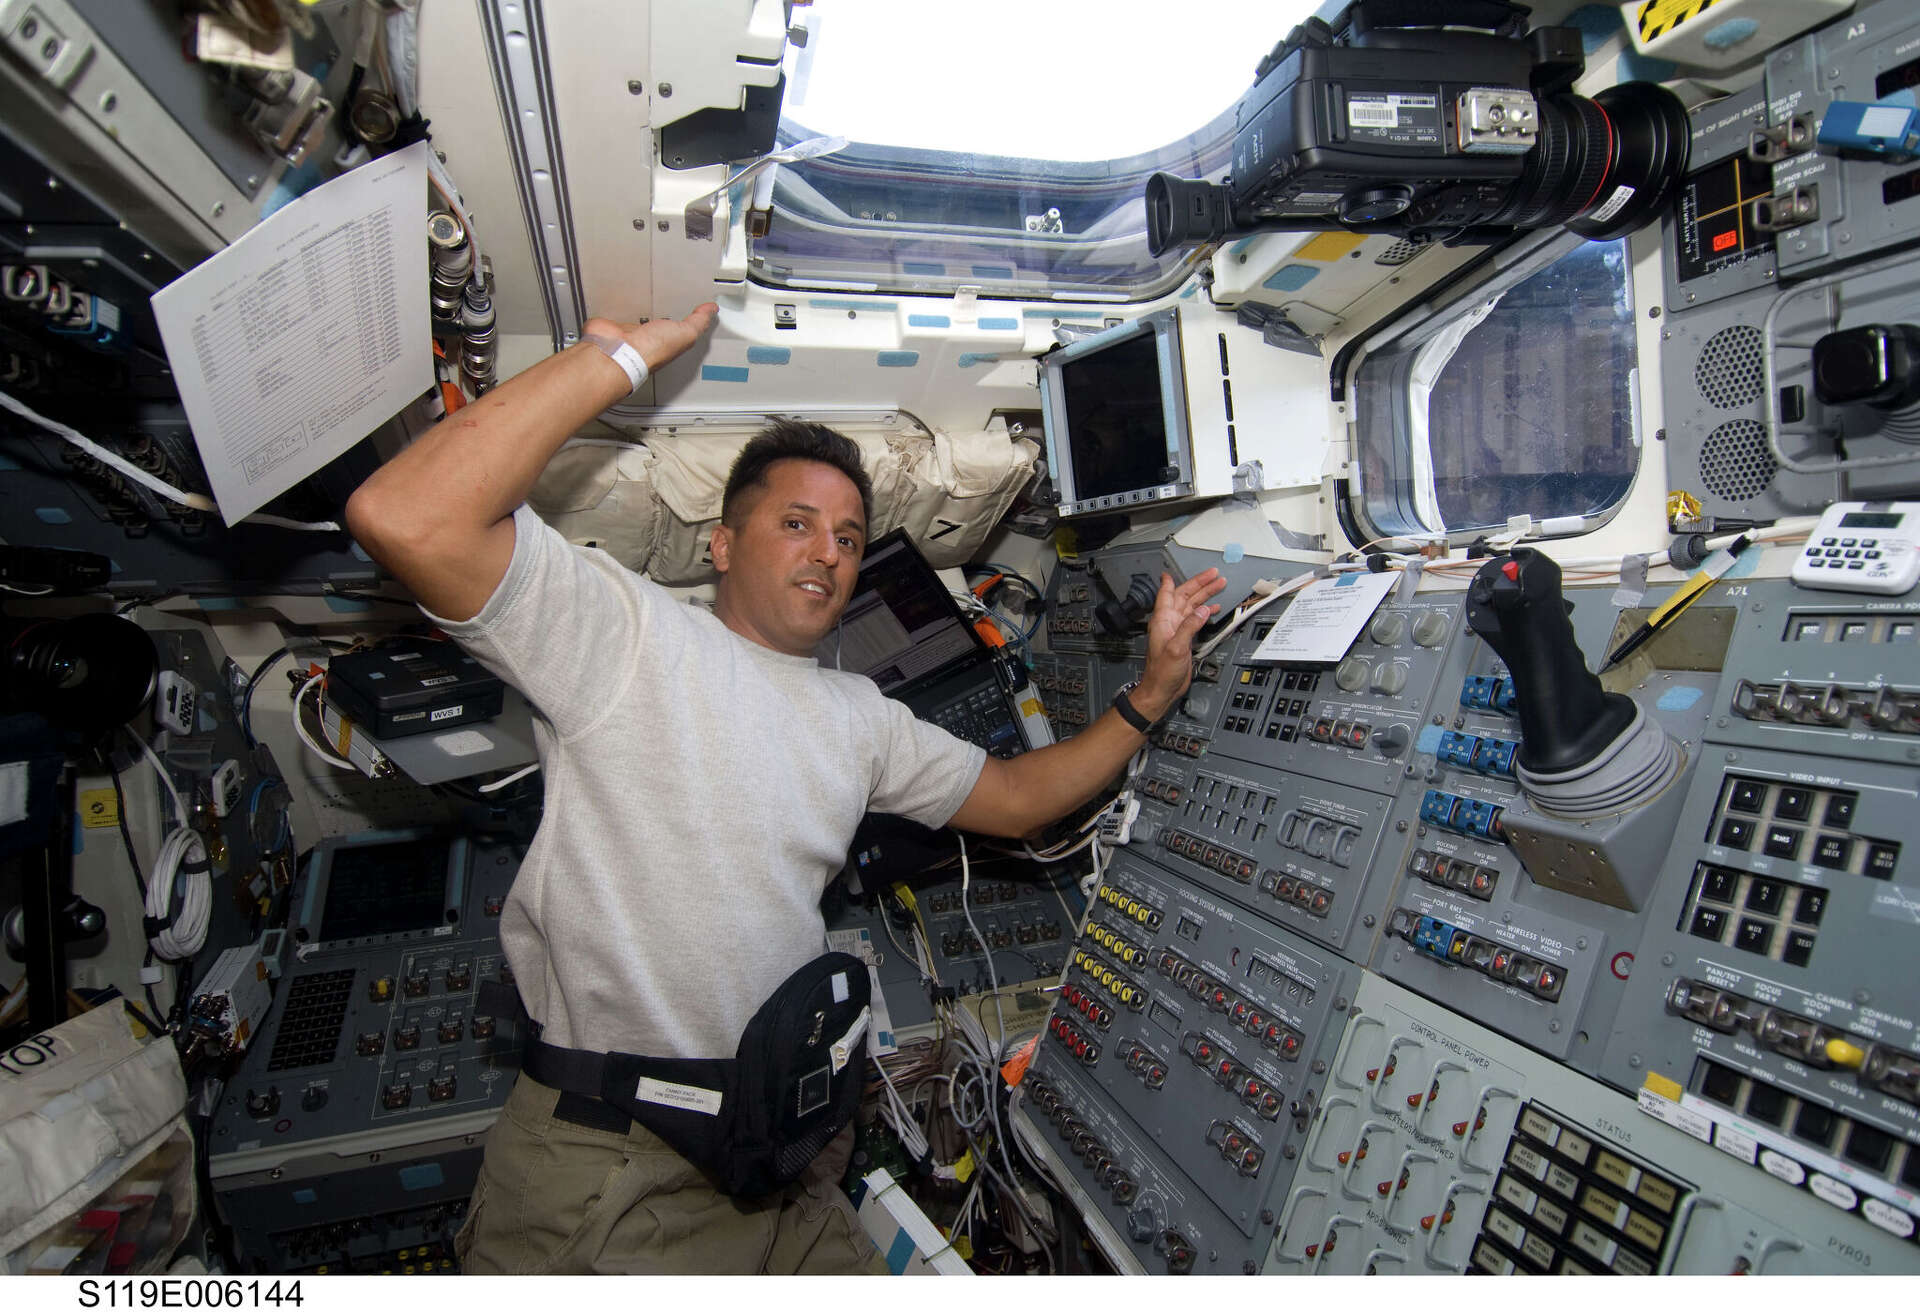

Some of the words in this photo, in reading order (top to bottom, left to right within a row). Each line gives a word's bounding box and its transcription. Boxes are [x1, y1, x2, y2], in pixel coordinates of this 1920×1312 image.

[1847, 23, 1866, 40] A2
[1705, 123, 1717, 133] OF
[1718, 112, 1740, 128] SIGHT
[1714, 231, 1736, 249] OFF
[434, 708, 454, 719] WVS
[1790, 773, 1815, 782] VIDEO
[1817, 776, 1841, 785] INPUT
[1436, 841, 1458, 850] DOCKING
[1773, 834, 1791, 843] RMS
[1420, 902, 1434, 910] LIGHT
[1432, 899, 1448, 909] PORT
[1449, 904, 1463, 913] RMS
[1215, 907, 1234, 922] POWER
[1455, 914, 1475, 925] CAMERA
[1495, 929, 1516, 939] HEATER
[1507, 925, 1538, 941] WIRELESS
[1540, 935, 1562, 949] VIDEO
[1797, 937, 1813, 947] TEST
[1540, 945, 1562, 957] POWER
[1706, 966, 1741, 982] PAN/TILT
[1707, 974, 1729, 987] RESET
[1506, 988, 1518, 996] OFF
[1755, 982, 1782, 996] FOCUS
[1755, 991, 1771, 1001] FAR
[1803, 998, 1831, 1013] ZOOM
[1805, 1007, 1816, 1016] IN
[1815, 993, 1853, 1010] CAMERA
[1861, 1008, 1912, 1029] COMMAND
[1696, 1028, 1714, 1040] LOW
[1850, 1022, 1875, 1037] OPEN
[1410, 1022, 1438, 1043] CONTROL
[1441, 1039, 1463, 1056] PANEL
[1464, 1050, 1490, 1070] POWER
[1692, 1035, 1712, 1048] RATE
[0, 1034, 57, 1074] TOP
[1751, 1067, 1776, 1082] MENU
[1829, 1080, 1858, 1096] CLOSE
[1882, 1100, 1916, 1120] DOWN
[1596, 1118, 1632, 1143] STATUS
